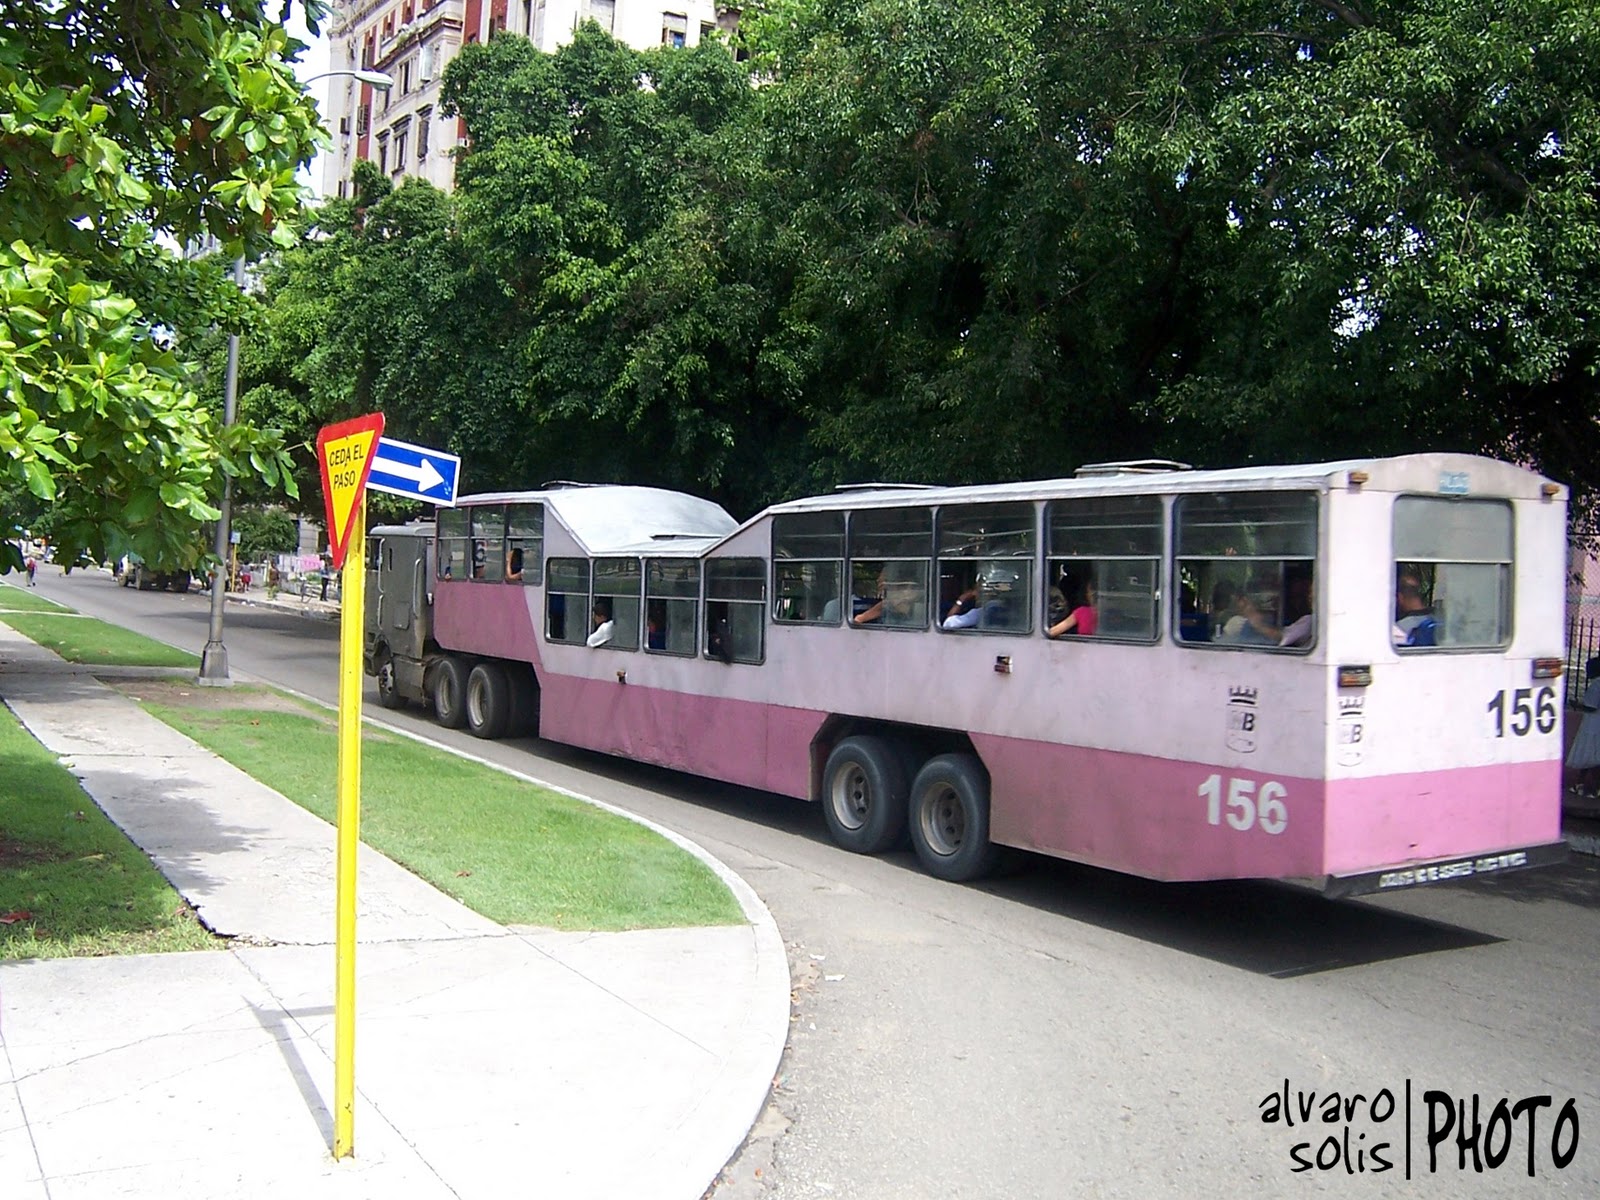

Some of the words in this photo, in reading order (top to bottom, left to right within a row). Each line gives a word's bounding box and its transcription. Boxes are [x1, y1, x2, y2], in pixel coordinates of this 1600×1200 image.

[329, 446, 351, 467] CEDA
[353, 443, 364, 460] EL
[333, 470, 356, 490] PASO
[1487, 686, 1557, 738] 156
[1198, 774, 1288, 835] 156
